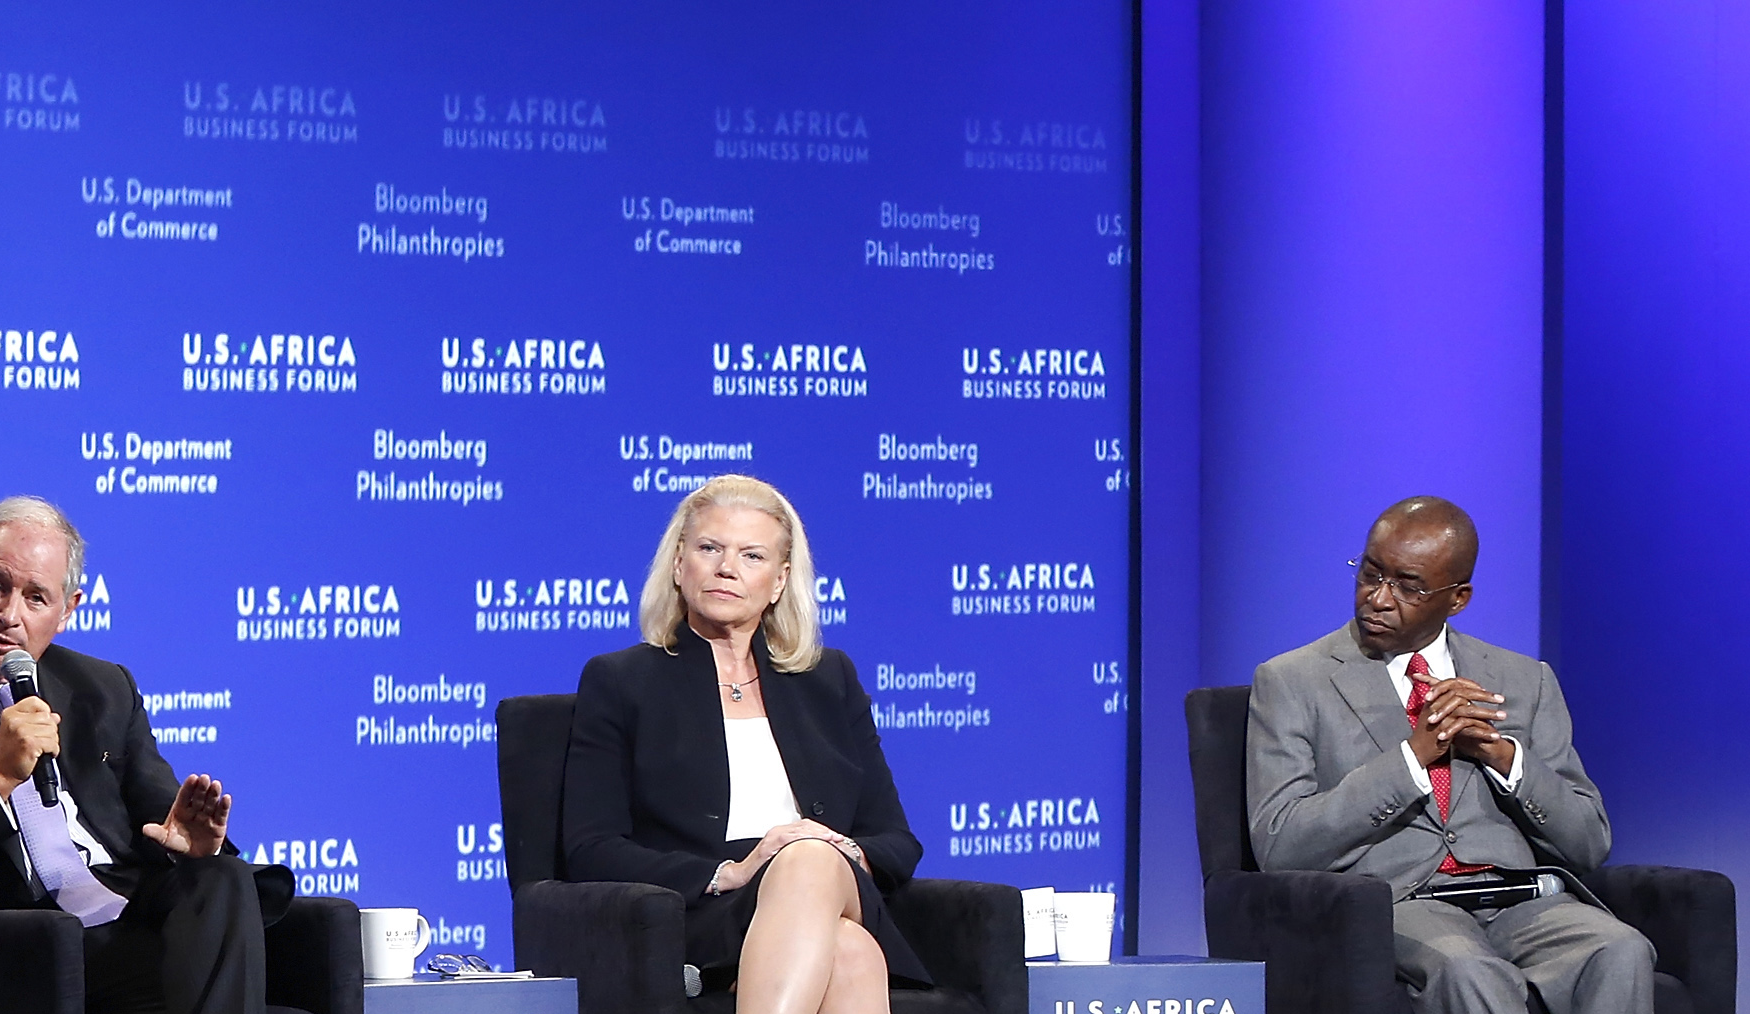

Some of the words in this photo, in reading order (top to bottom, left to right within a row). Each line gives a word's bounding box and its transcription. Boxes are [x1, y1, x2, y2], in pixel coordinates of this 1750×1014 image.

[5, 108, 80, 131] FORUM
[82, 177, 119, 203] U.S.
[127, 179, 231, 210] Department
[375, 183, 487, 223] Bloomberg
[97, 212, 115, 237] of
[121, 212, 217, 240] Commerce
[358, 223, 504, 261] Philanthropies
[183, 333, 238, 365] U.S.
[250, 335, 355, 366] AFRICA
[714, 343, 762, 371] U.S.
[772, 345, 866, 372] AFRICA
[963, 348, 1008, 374] U.S.
[1018, 350, 1104, 375] AFRICA
[4, 366, 79, 389] FORUM
[184, 368, 278, 391] BUSINESS
[287, 369, 356, 391] FORUM
[714, 376, 797, 395] BUSINESS
[805, 377, 866, 396] FORUM
[963, 380, 1041, 398] BUSINESS
[1048, 381, 1105, 398] FORUM
[82, 432, 119, 459] U.S.
[126, 433, 231, 464] Department
[374, 429, 486, 467] Bloomberg
[620, 436, 653, 460] U.S.
[659, 436, 752, 464] Department
[879, 434, 977, 468] Bloomberg
[96, 467, 115, 493] of
[121, 467, 217, 493] Commerce
[357, 471, 502, 506] Philanthropies
[632, 467, 651, 492] of
[863, 472, 992, 504] Philanthropies
[1106, 468, 1121, 491] of
[953, 564, 997, 591] U.S.
[1007, 563, 1094, 589] AFRICA
[237, 586, 289, 616] U.S.
[300, 585, 399, 614] AFRICA
[476, 580, 524, 607] U.S.
[535, 579, 628, 605] AFRICA
[953, 596, 1030, 614] BUSINESS
[1038, 595, 1094, 612] FORUM
[238, 618, 326, 640] BUSINESS
[334, 618, 399, 638] FORUM
[477, 611, 560, 630] BUSINESS
[568, 610, 629, 628] FORUM
[374, 674, 486, 708] Bloomberg
[877, 664, 975, 695] Bloomberg
[138, 688, 231, 716] epartment
[871, 702, 990, 731] hilanthropies
[151, 726, 217, 744] mmerce
[951, 803, 998, 831] U.S.
[1008, 798, 1099, 828] AFRICA
[951, 834, 1032, 855] BUSINESS
[1040, 831, 1099, 850] FORUM
[295, 873, 359, 894] ORUM
